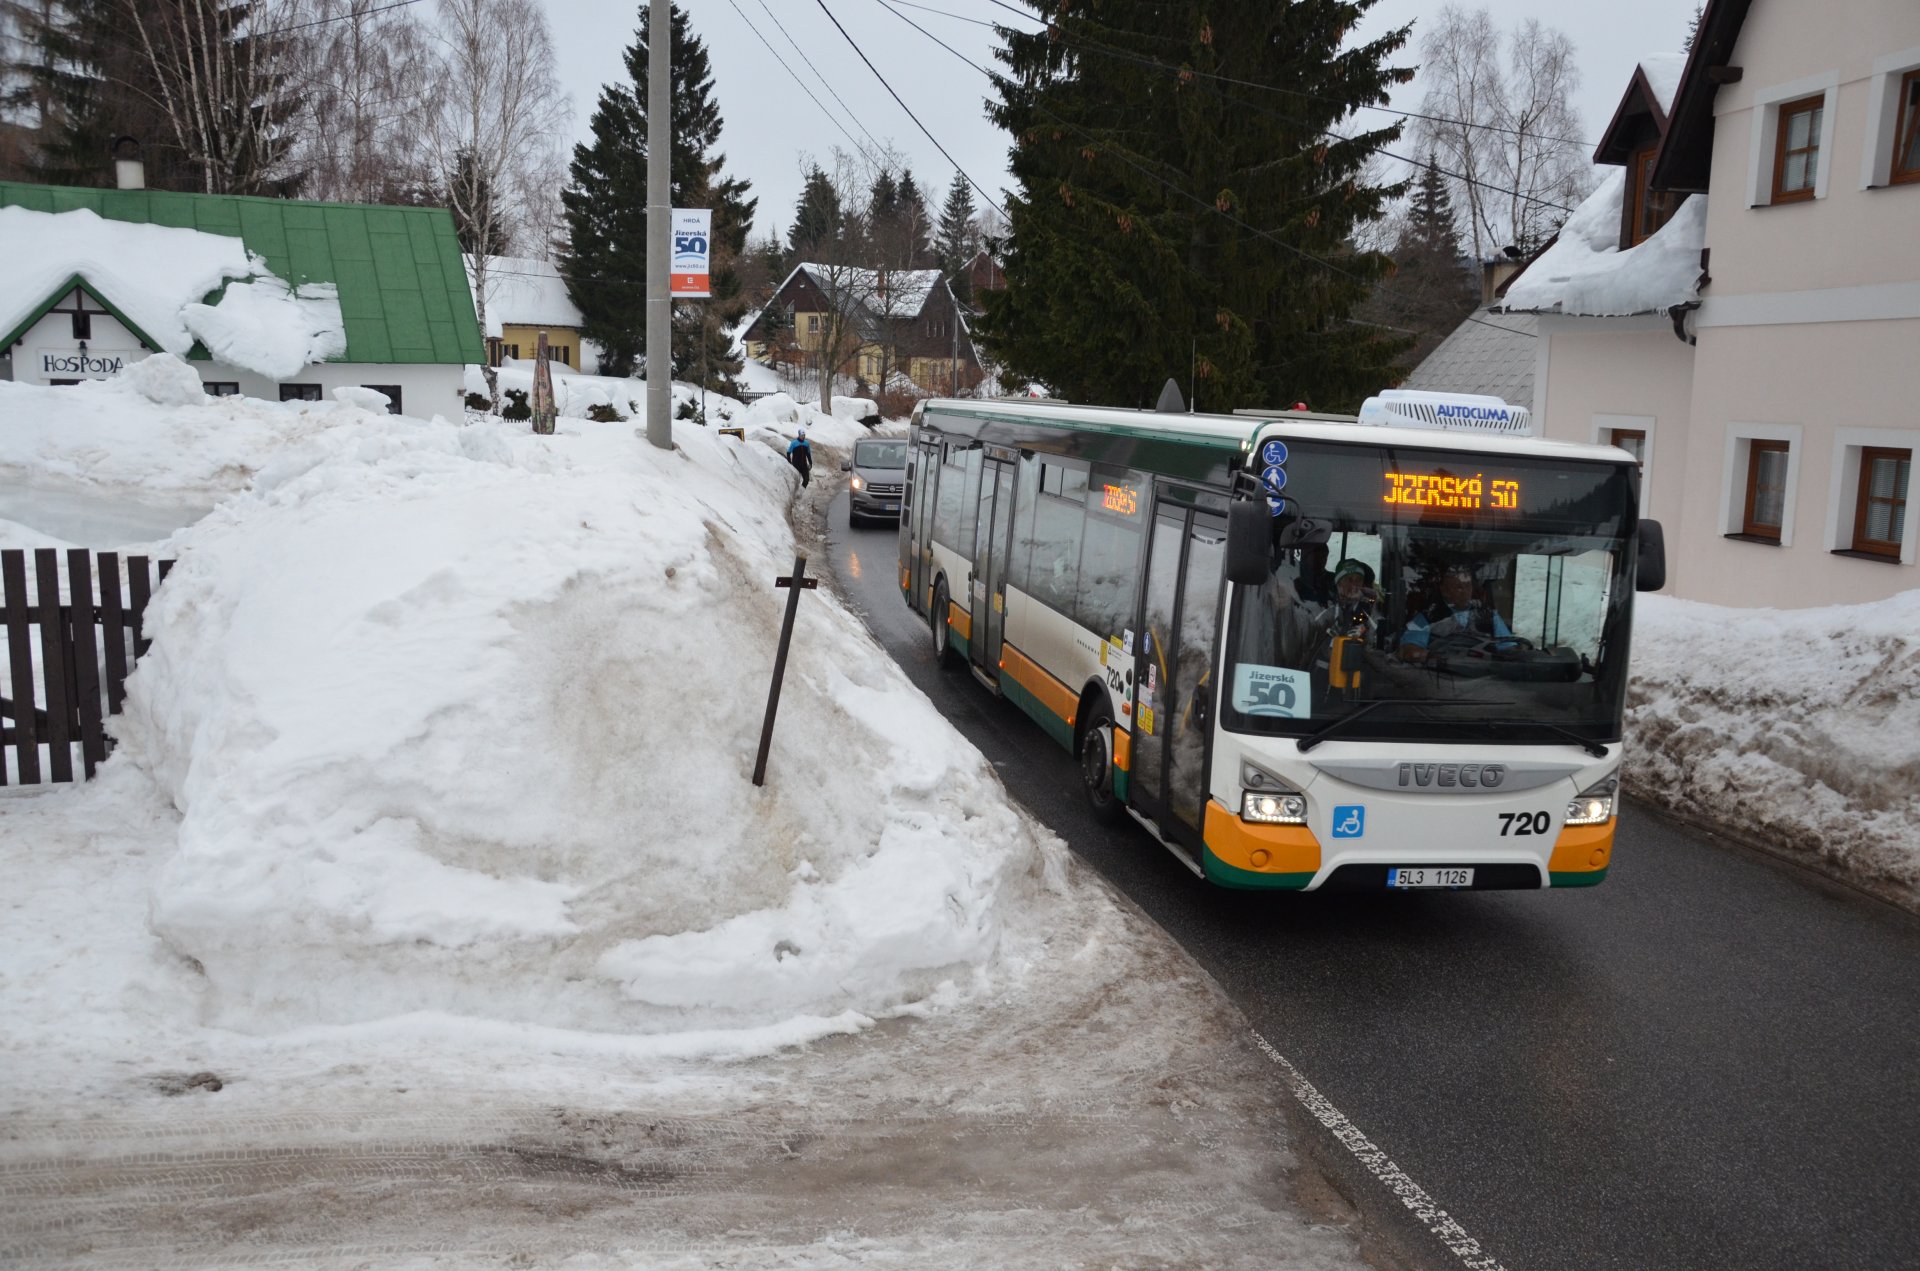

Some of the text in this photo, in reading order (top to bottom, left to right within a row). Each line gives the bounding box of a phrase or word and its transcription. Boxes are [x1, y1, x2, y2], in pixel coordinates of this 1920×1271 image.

[675, 229, 707, 237] Jizerská
[675, 237, 708, 254] 50
[43, 355, 124, 373] HOSPODA
[1437, 404, 1510, 422] AUTOCLIMA
[1383, 473, 1519, 509] JIZERSKÁ 50
[1106, 666, 1121, 692] 720
[1249, 670, 1295, 684] Jizerská
[1246, 681, 1297, 710] 50
[1398, 763, 1505, 788] IVECO
[1498, 811, 1551, 837] 720
[1399, 870, 1468, 885] 5L3 1126
